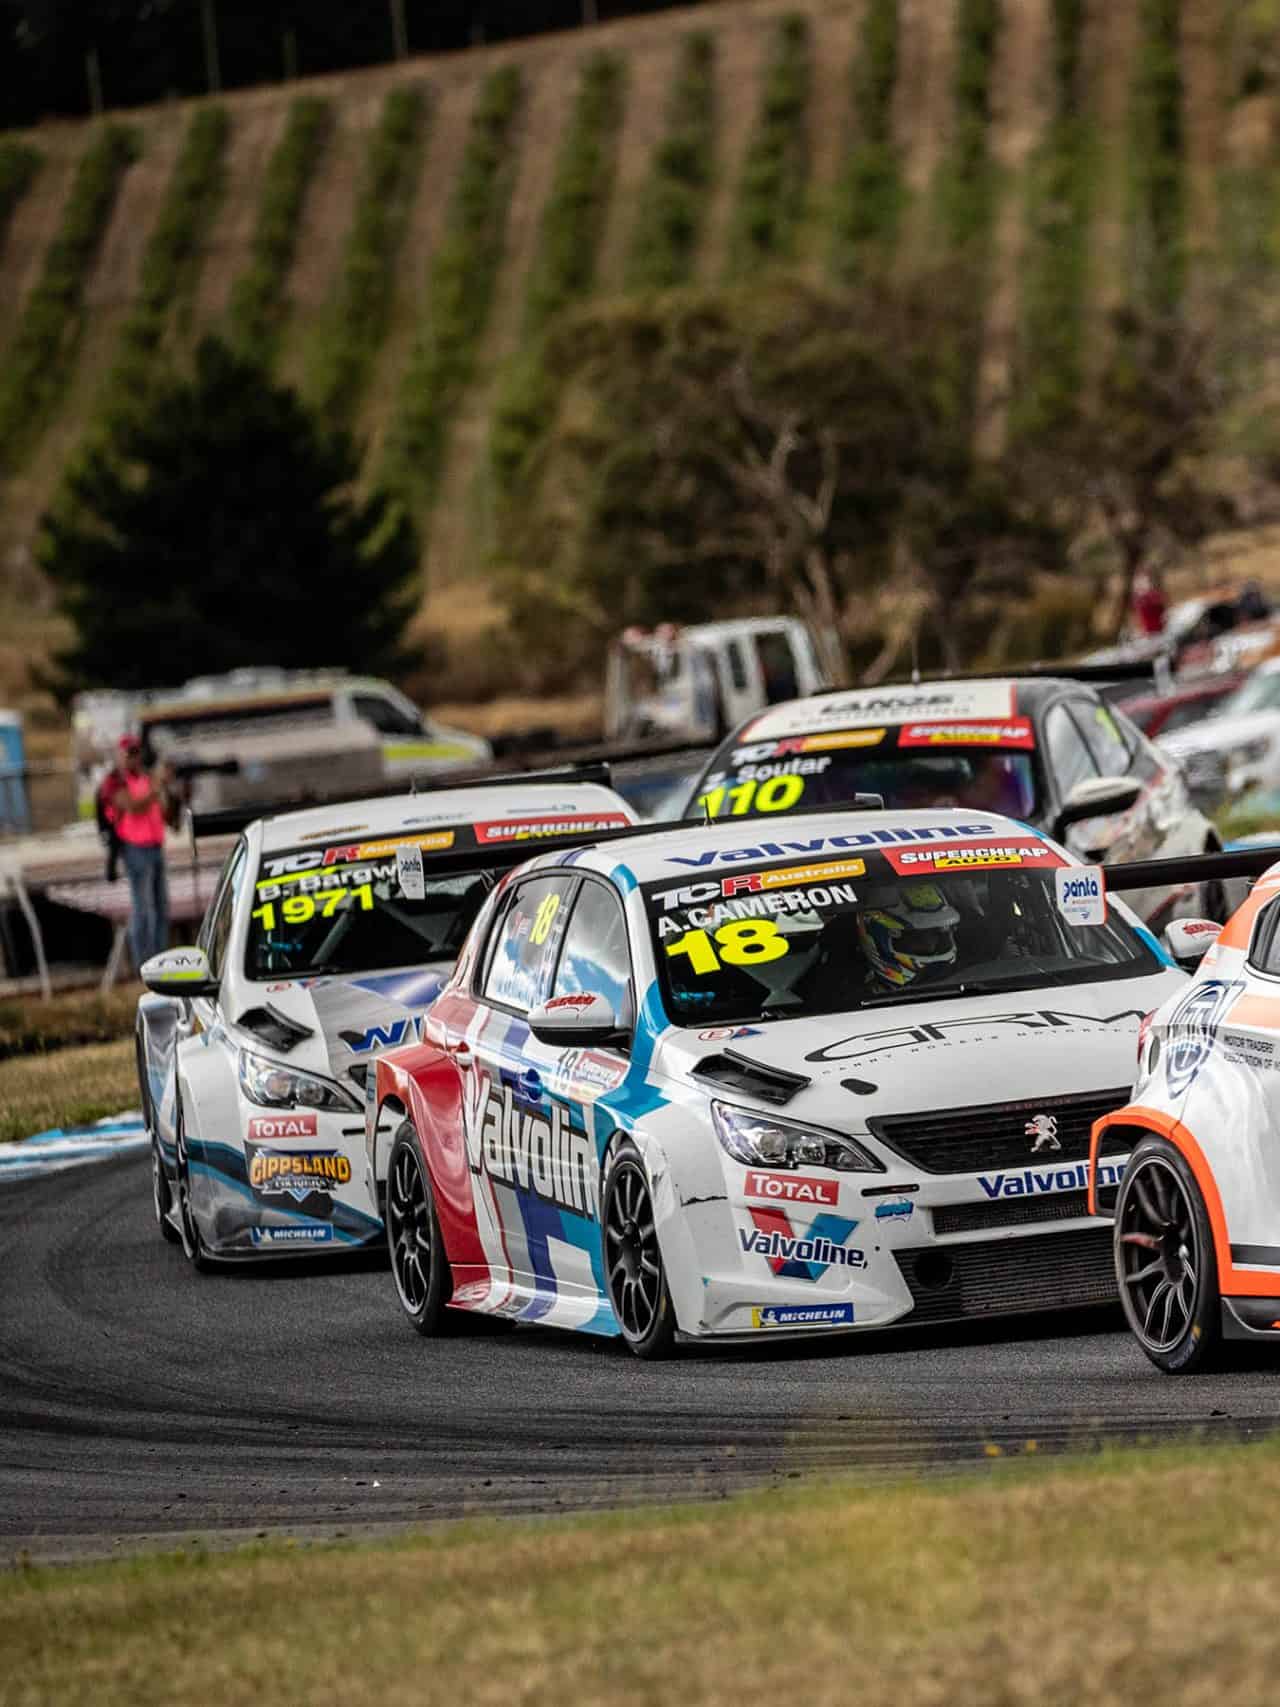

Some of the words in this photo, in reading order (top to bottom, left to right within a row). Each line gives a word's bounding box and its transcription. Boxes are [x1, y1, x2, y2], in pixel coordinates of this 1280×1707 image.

[736, 756, 832, 784] Soutar
[698, 774, 804, 819] 110
[664, 824, 995, 866] Valvoline
[900, 847, 1049, 865] SUPERCHEAP
[945, 855, 1011, 866] AUTO
[263, 845, 361, 878] TCR
[299, 863, 399, 894] Bargw
[651, 872, 763, 911] TCR
[766, 864, 861, 885] Australia
[251, 883, 375, 932] 1971
[529, 893, 561, 945] 18
[665, 919, 790, 976] 18
[252, 1119, 312, 1136] TOTAL
[463, 1070, 598, 1216] Valvolin
[249, 1154, 352, 1185] GIPPSLAND
[750, 1173, 832, 1202] TOTAL
[273, 1229, 327, 1239] MICHELIN
[780, 1309, 846, 1323] MICHELIN
